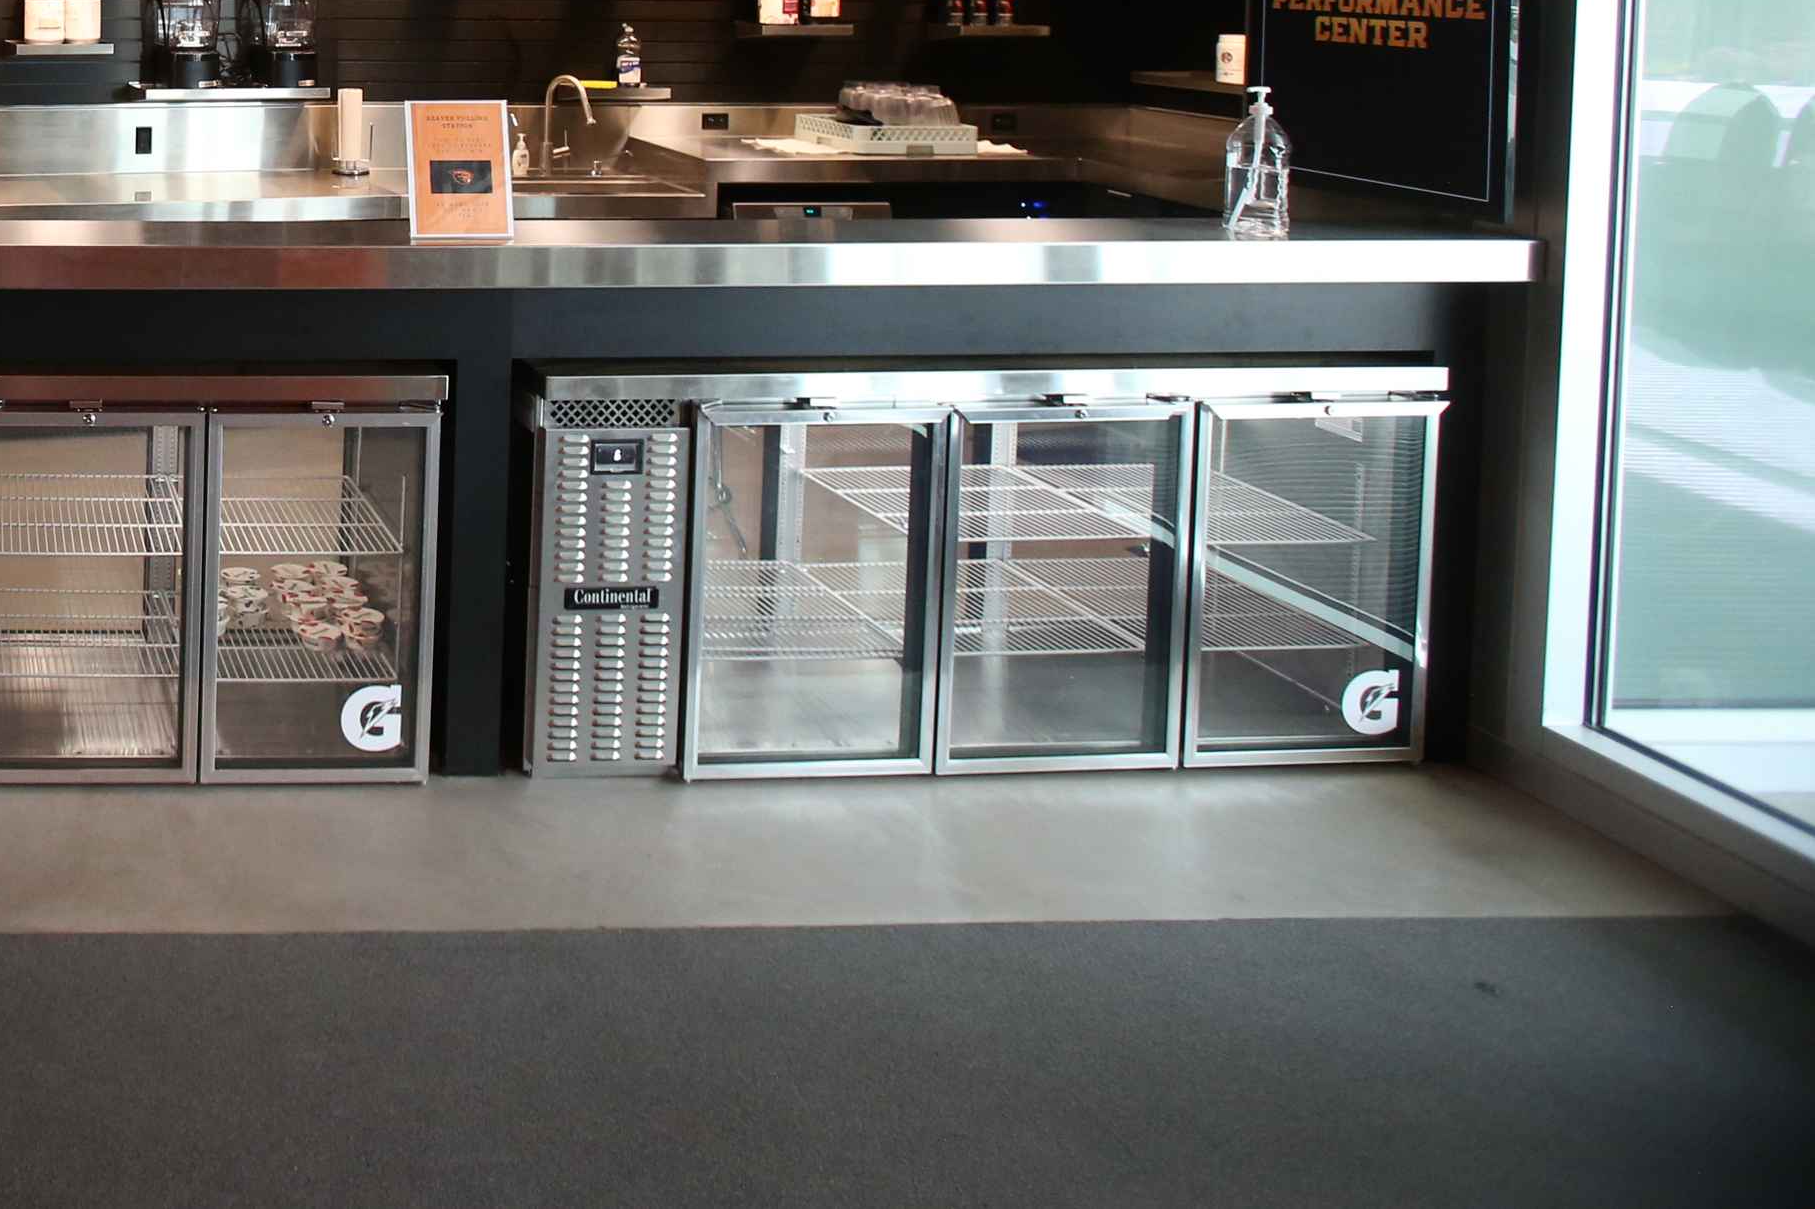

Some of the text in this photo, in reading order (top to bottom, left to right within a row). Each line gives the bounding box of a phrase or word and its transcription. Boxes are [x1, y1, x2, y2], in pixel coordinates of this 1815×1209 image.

[1315, 16, 1427, 49] CENTER
[574, 588, 652, 605] Continental
[340, 684, 402, 752] G
[1341, 669, 1400, 736] G
